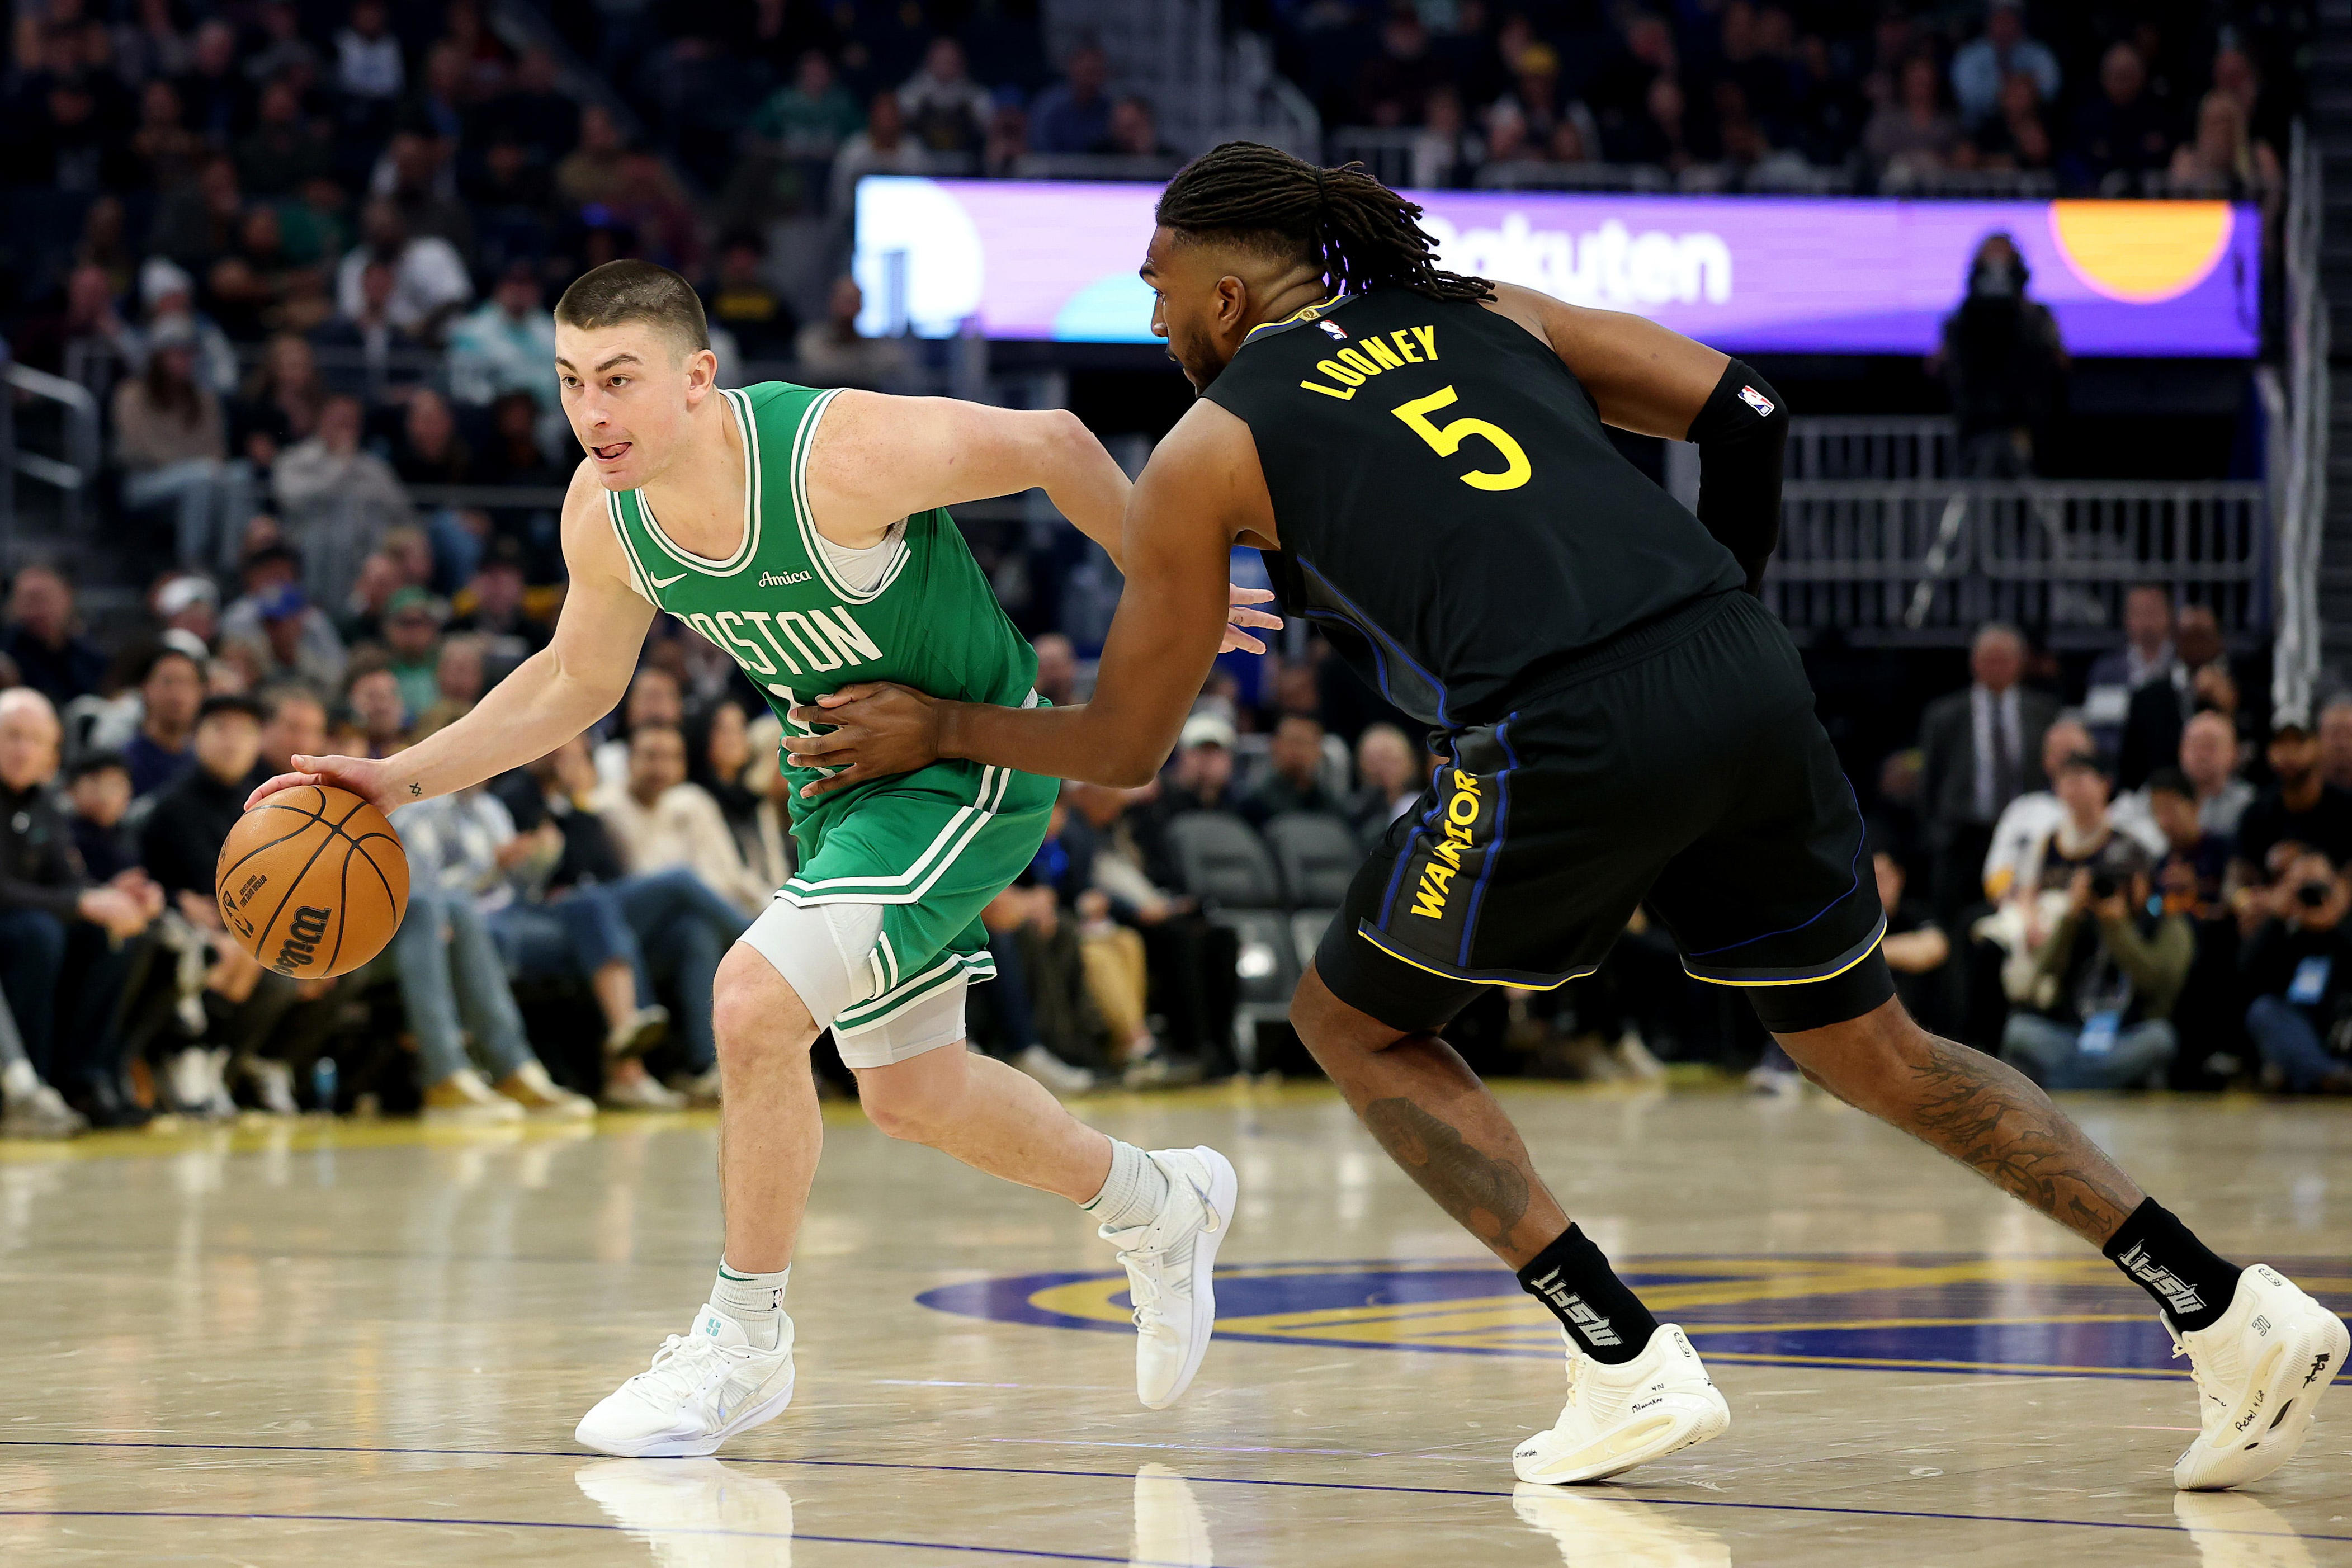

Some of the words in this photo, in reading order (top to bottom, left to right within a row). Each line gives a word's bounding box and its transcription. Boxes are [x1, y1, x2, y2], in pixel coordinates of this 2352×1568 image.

[1300, 325, 1439, 400] LOONEY
[1391, 385, 1532, 491] 5
[759, 570, 813, 587] Amica
[2251, 1315, 2271, 1336] 31
[2235, 1409, 2257, 1432] Rebel
